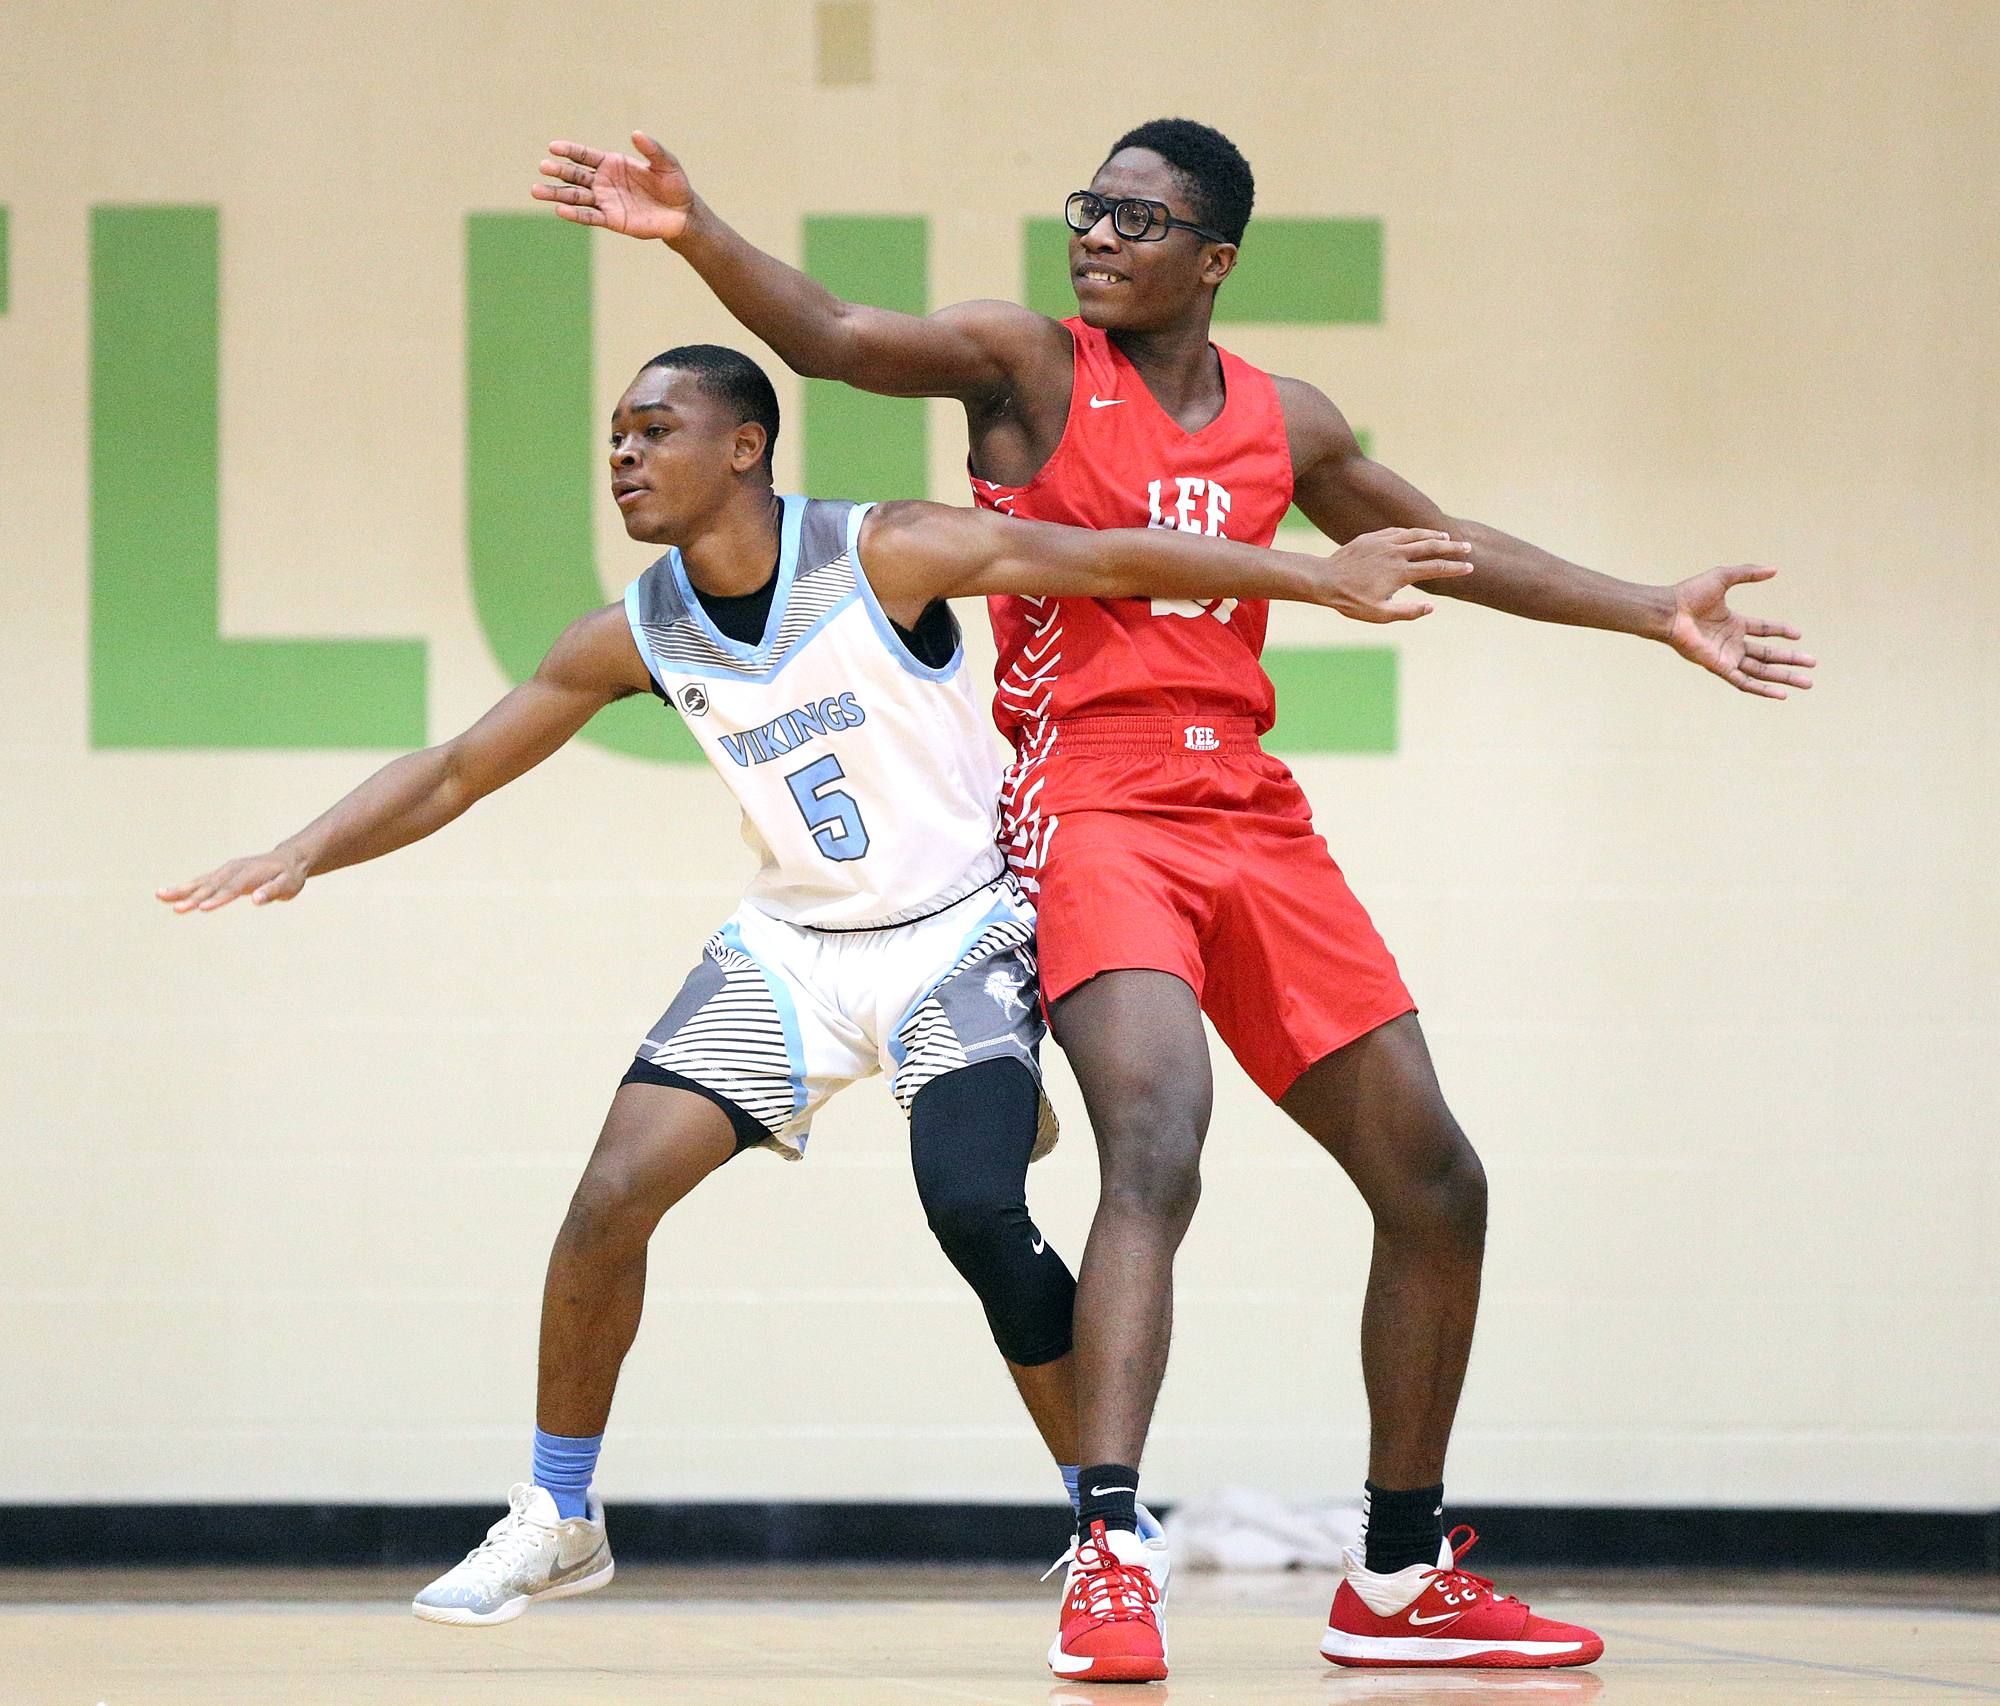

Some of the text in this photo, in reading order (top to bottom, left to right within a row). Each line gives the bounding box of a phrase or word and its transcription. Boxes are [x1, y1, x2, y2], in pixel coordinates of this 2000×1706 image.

[0, 203, 1400, 765] LUE
[1147, 477, 1231, 539] LEE
[717, 692, 866, 767] VIKINGS
[1184, 725, 1220, 751] LEE
[784, 753, 870, 862] 5
